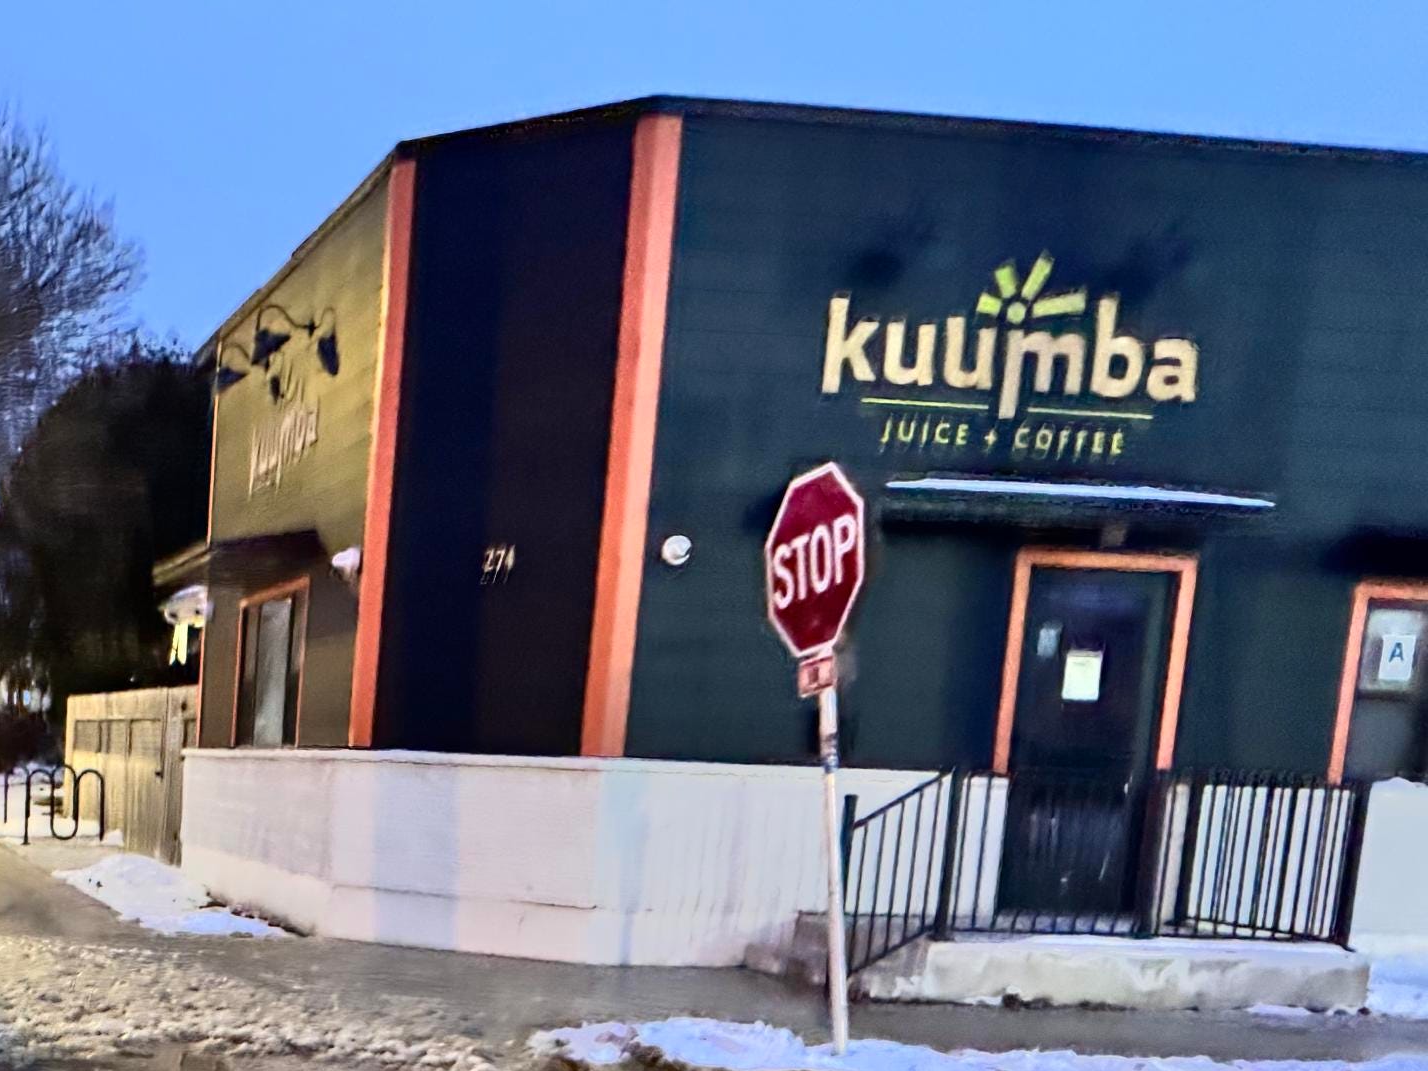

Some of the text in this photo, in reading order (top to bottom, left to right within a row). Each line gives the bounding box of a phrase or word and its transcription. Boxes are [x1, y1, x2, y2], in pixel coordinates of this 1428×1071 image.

[821, 293, 1199, 419] kuumba
[879, 416, 970, 446] JUICE
[1014, 425, 1124, 456] COFFEE
[775, 515, 855, 610] STOP
[1388, 641, 1404, 663] A
